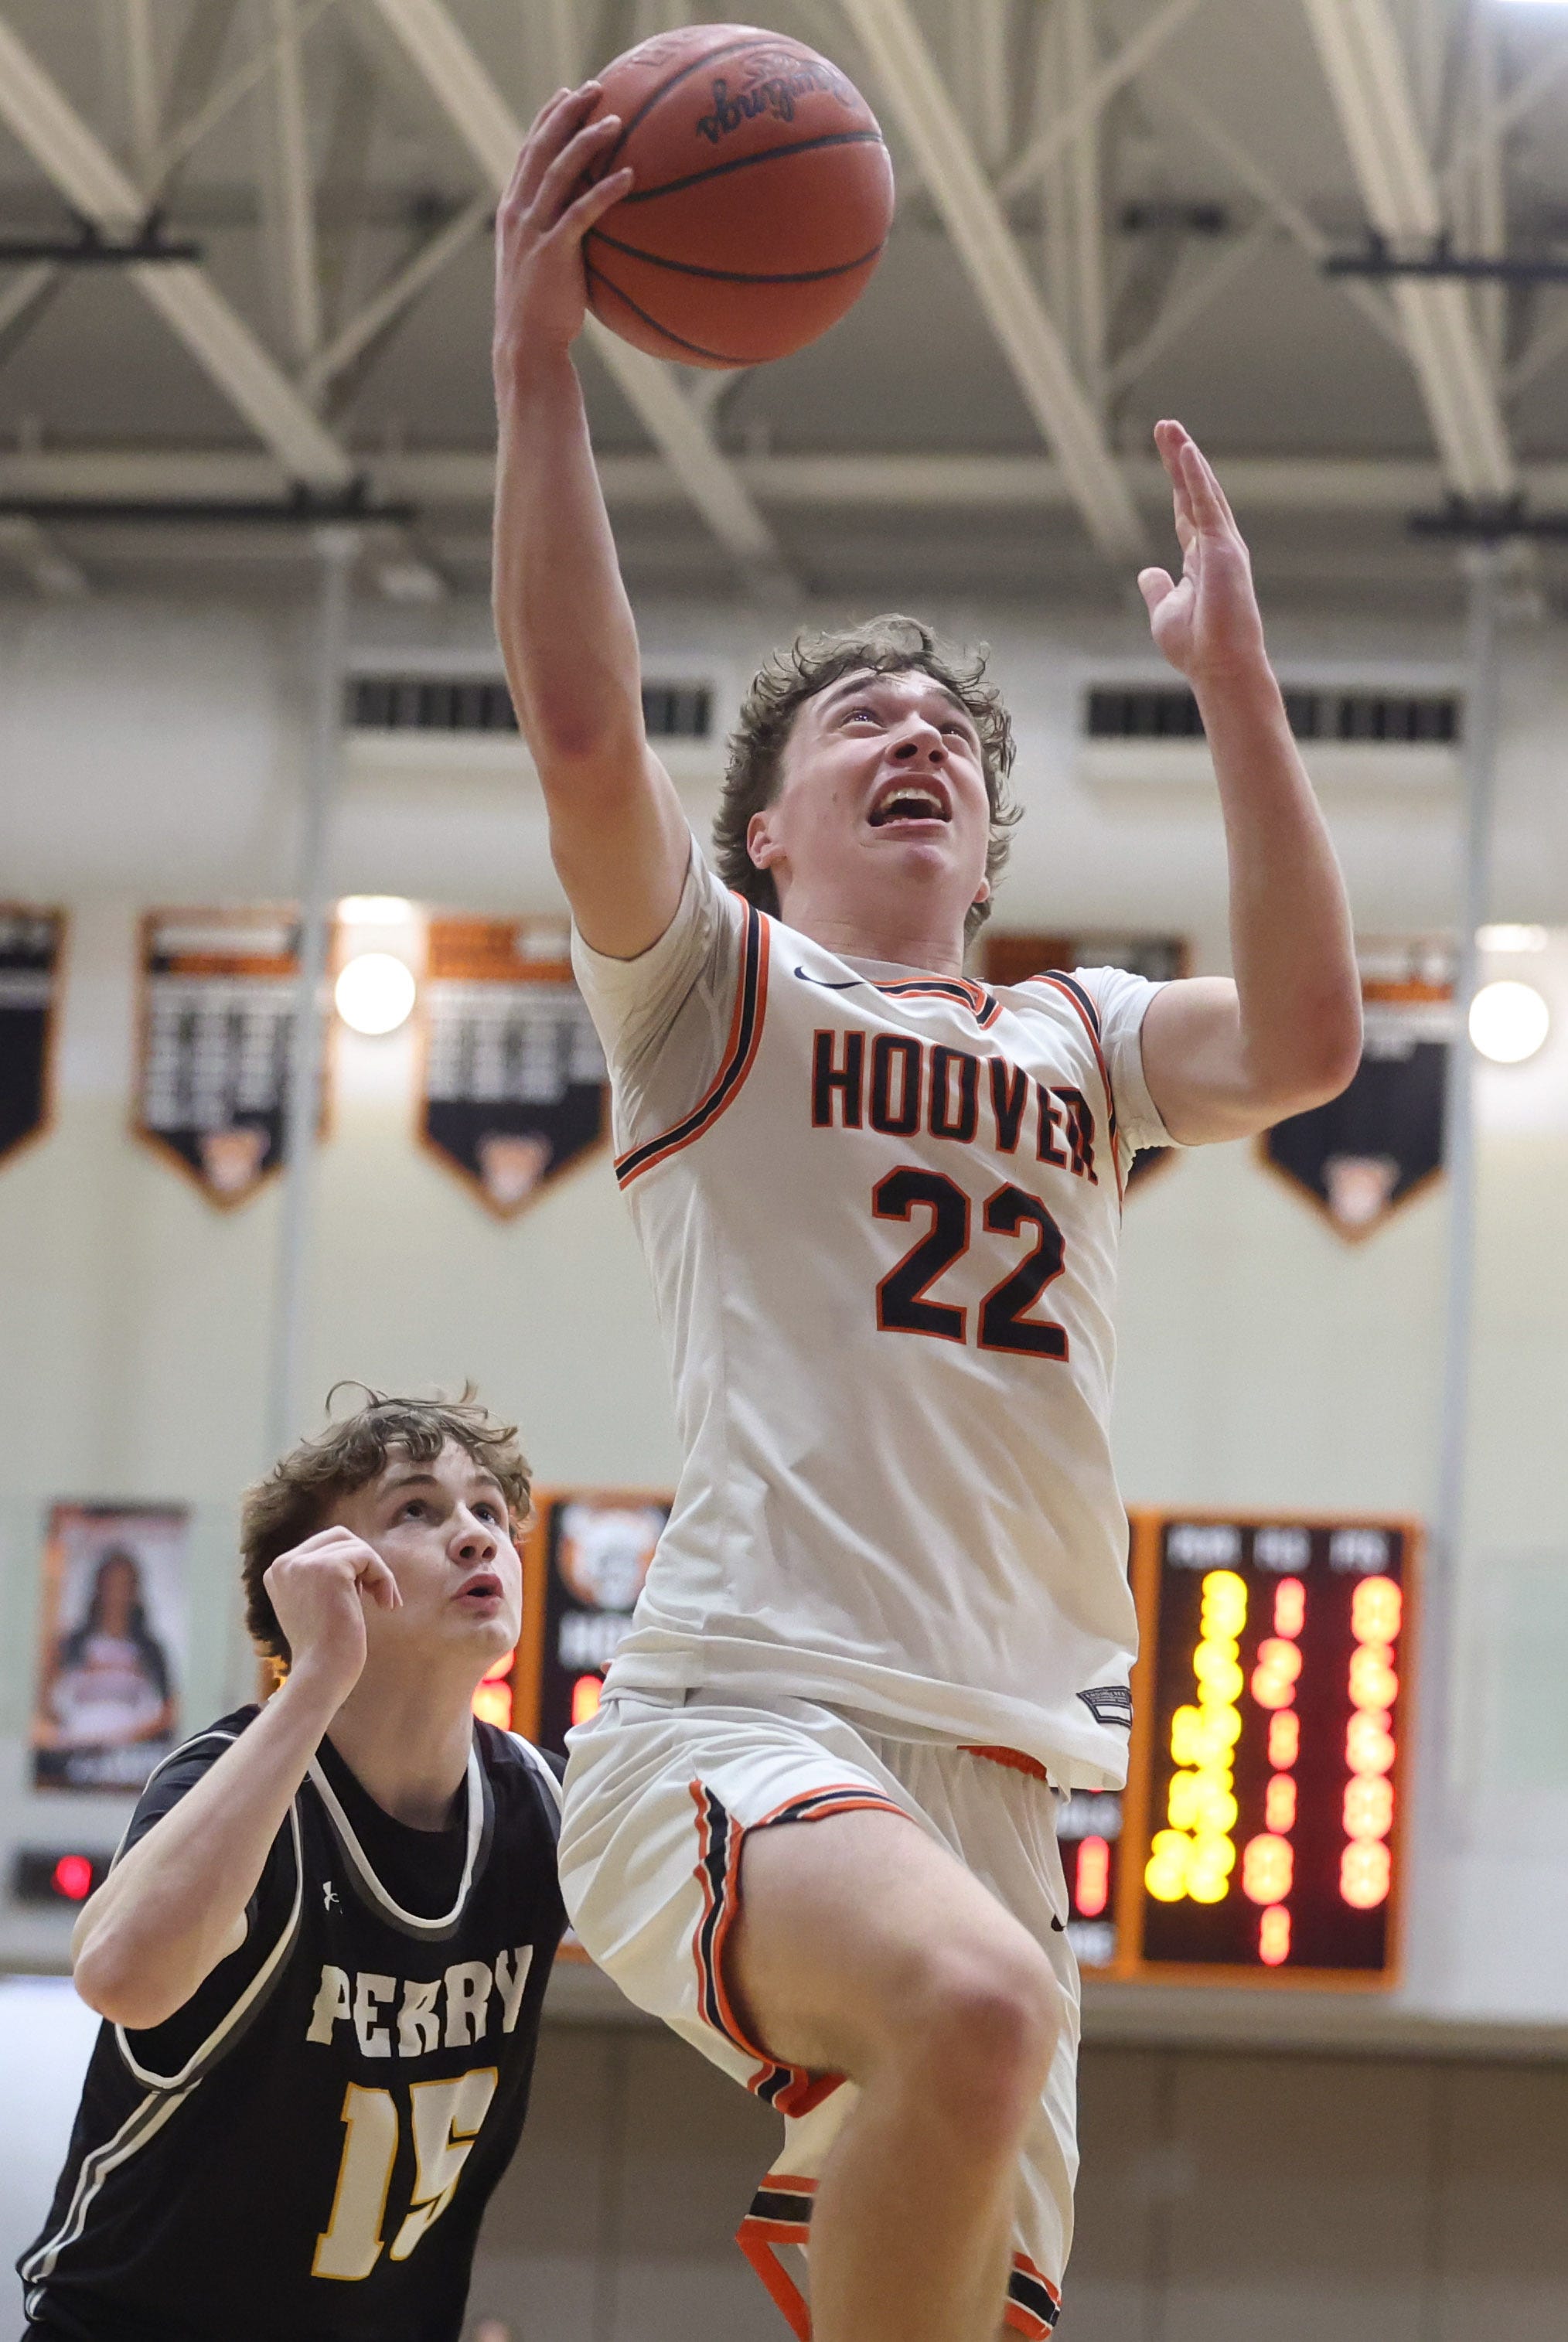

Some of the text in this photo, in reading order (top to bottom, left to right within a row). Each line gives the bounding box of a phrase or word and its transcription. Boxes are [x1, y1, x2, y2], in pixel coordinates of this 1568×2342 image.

[811, 1029, 1098, 1185] HOOVER
[871, 1165, 1069, 1363] 22
[1275, 1577, 1305, 1638] 1
[1251, 1638, 1303, 1710] 2
[1269, 1709, 1299, 1769] 1
[1266, 1773, 1297, 1834] 1
[1144, 1829, 1236, 1904] 22
[1259, 1904, 1290, 1965] 1
[306, 1944, 534, 2057] PERRY
[311, 2067, 499, 2280] 15
